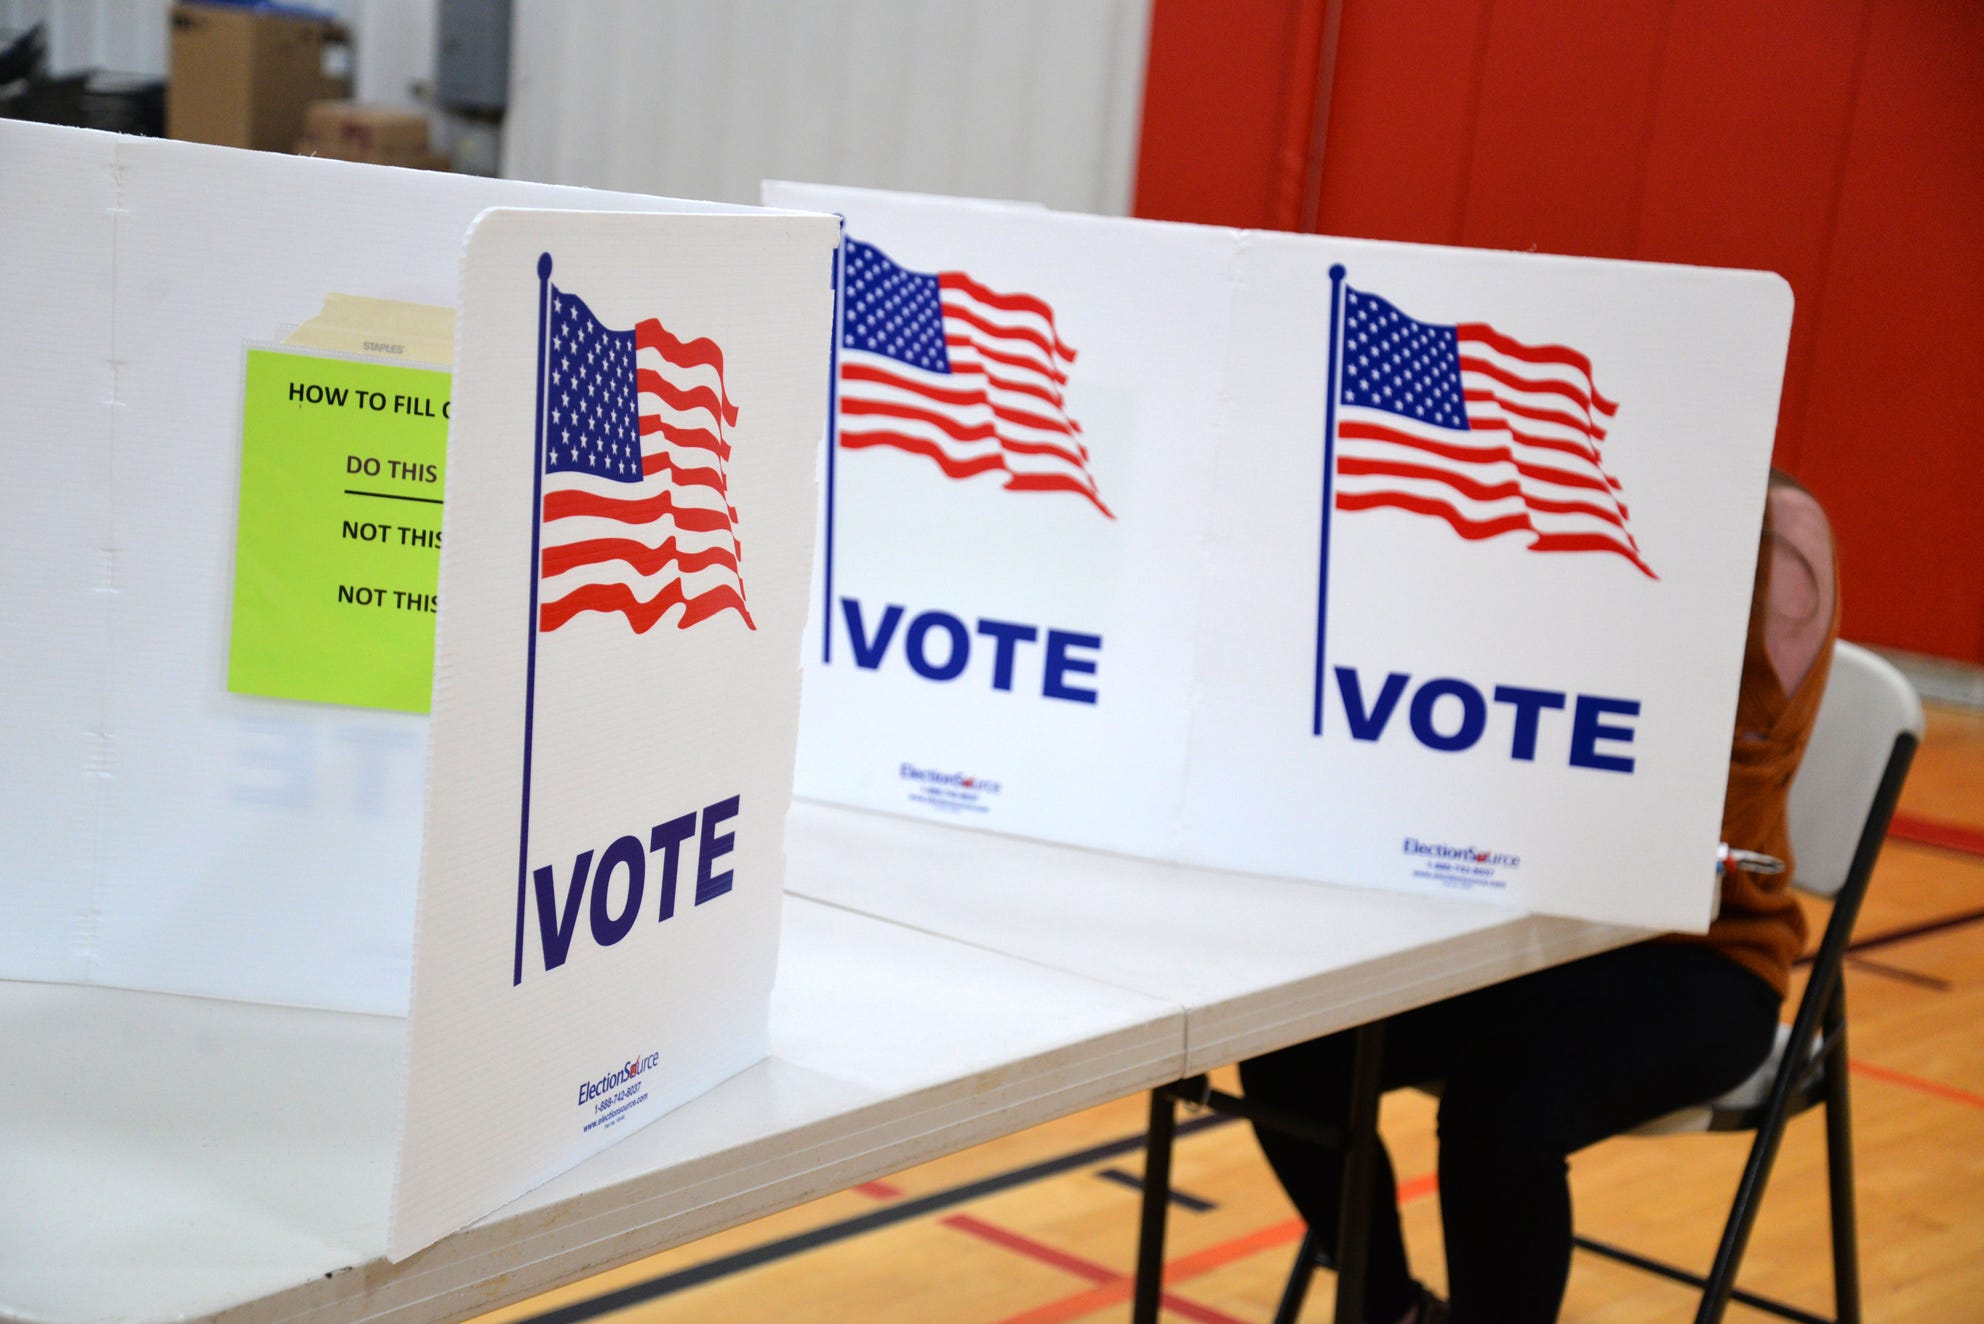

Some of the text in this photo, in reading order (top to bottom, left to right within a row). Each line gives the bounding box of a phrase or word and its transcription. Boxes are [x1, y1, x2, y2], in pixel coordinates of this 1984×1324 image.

[288, 382, 349, 407] HOW
[355, 390, 387, 412] TO
[393, 395, 436, 419] FILL
[346, 455, 438, 483] DO THIS
[342, 520, 392, 544] NOT
[337, 584, 387, 607] NOT
[839, 596, 1103, 705] VOTE
[1333, 665, 1642, 775] VOTE
[532, 793, 741, 972] VOTE
[578, 1051, 659, 1106] ElectionSource
